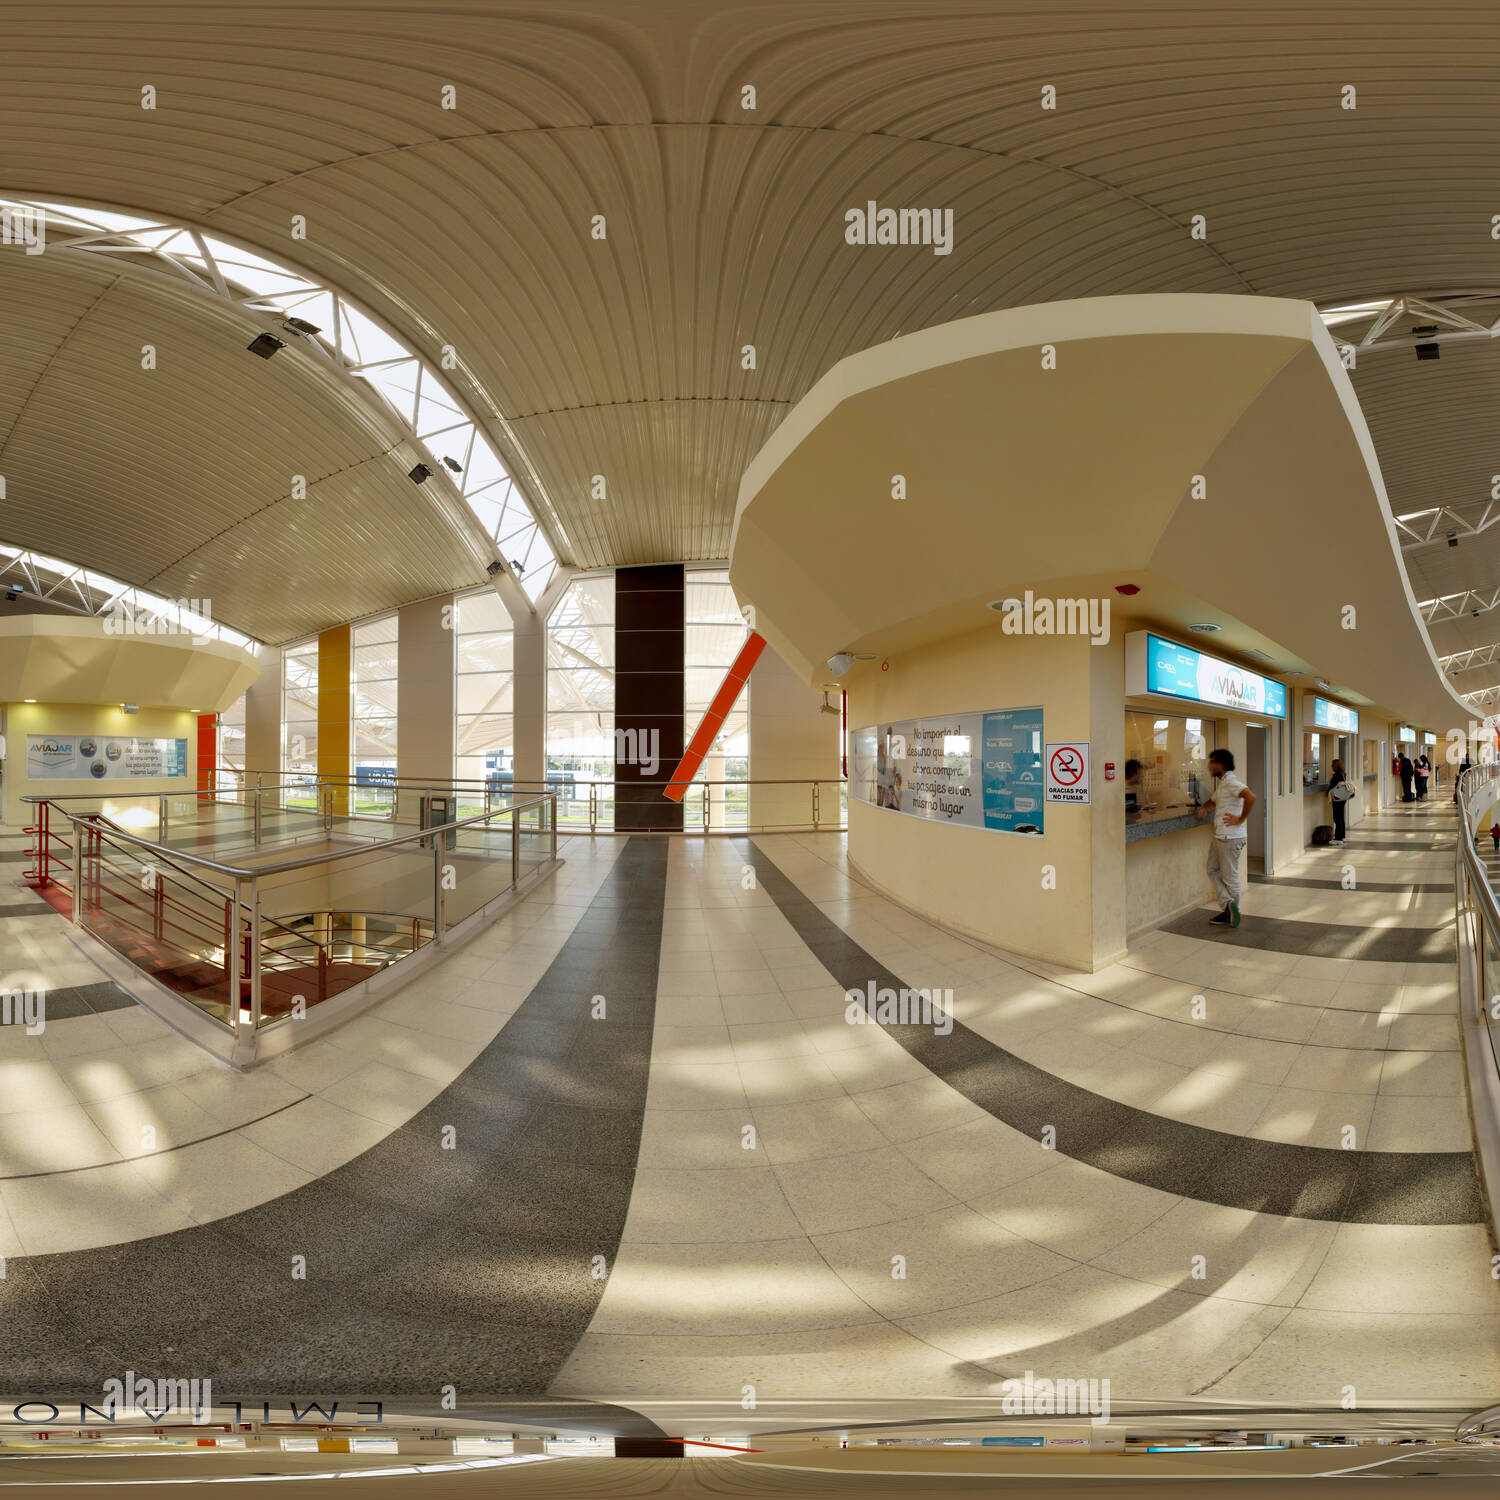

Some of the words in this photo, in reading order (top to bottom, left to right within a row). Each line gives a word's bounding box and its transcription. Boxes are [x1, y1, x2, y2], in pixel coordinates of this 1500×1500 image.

[881, 656, 890, 672] 6
[1211, 671, 1257, 704] AVIAJAR
[913, 727, 922, 740] No
[30, 743, 73, 753] AVIAJAR
[916, 780, 947, 798] pasajes
[1075, 787, 1088, 795] POR
[912, 797, 938, 812] mismo
[940, 797, 965, 819] lugar
